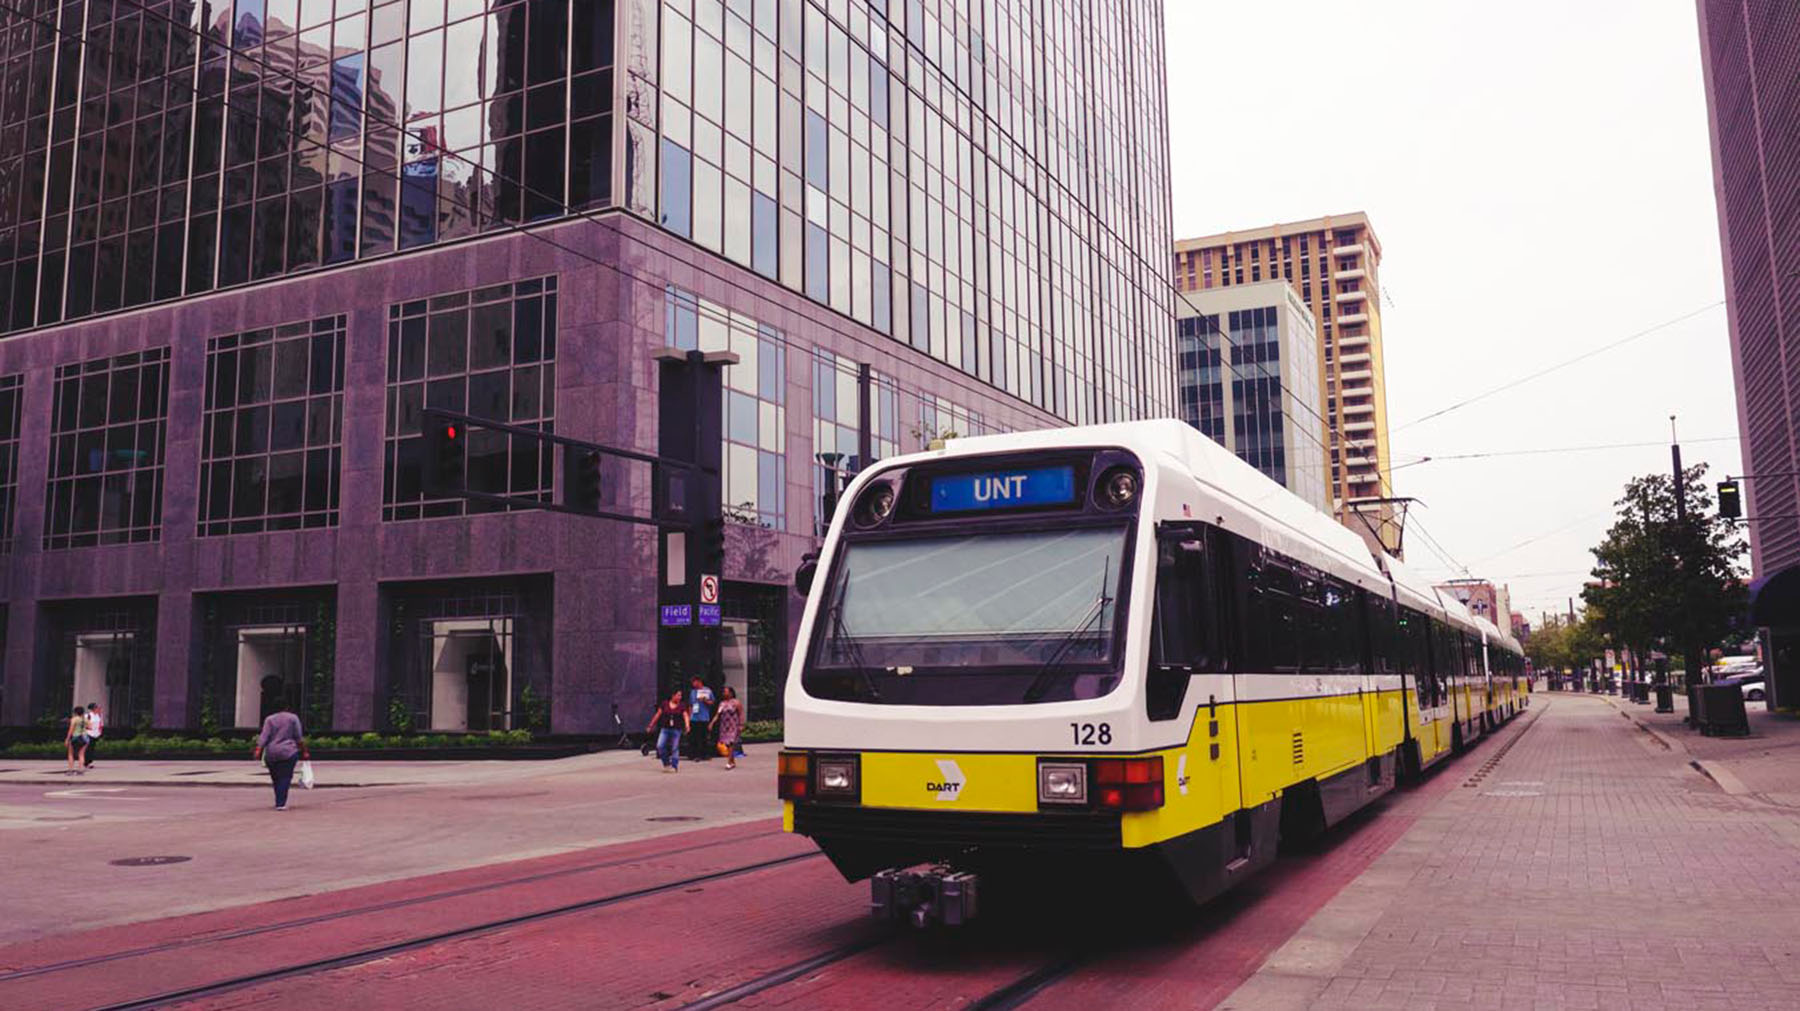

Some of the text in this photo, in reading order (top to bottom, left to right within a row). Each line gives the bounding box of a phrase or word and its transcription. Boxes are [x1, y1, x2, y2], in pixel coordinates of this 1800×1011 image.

[974, 475, 1028, 501] UNT
[665, 606, 688, 616] Field
[1070, 722, 1112, 745] 128
[926, 782, 960, 792] DART
